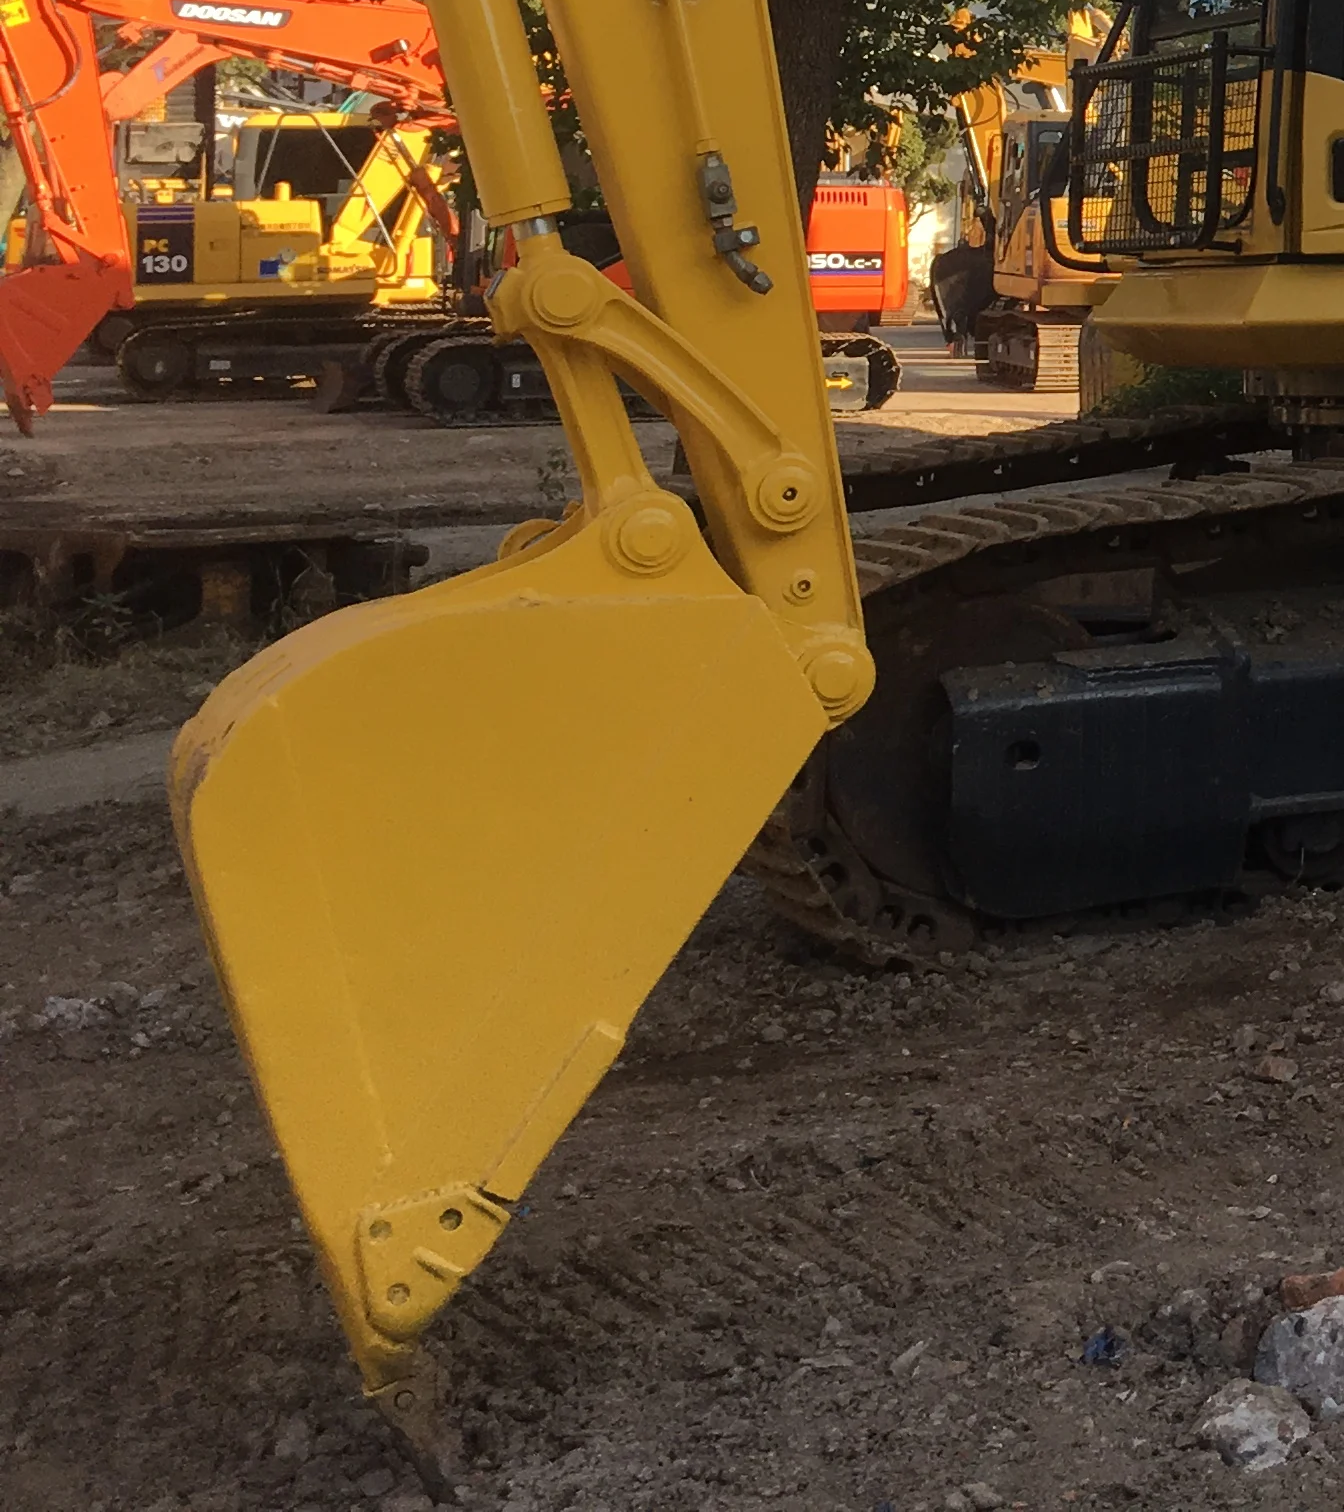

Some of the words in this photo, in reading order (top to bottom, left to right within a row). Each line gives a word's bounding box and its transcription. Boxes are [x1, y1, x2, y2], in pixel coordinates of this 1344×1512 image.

[178, 3, 283, 26] DOOSAN
[143, 239, 169, 253] PC
[142, 255, 188, 273] 130
[807, 253, 881, 268] 50LC-7
